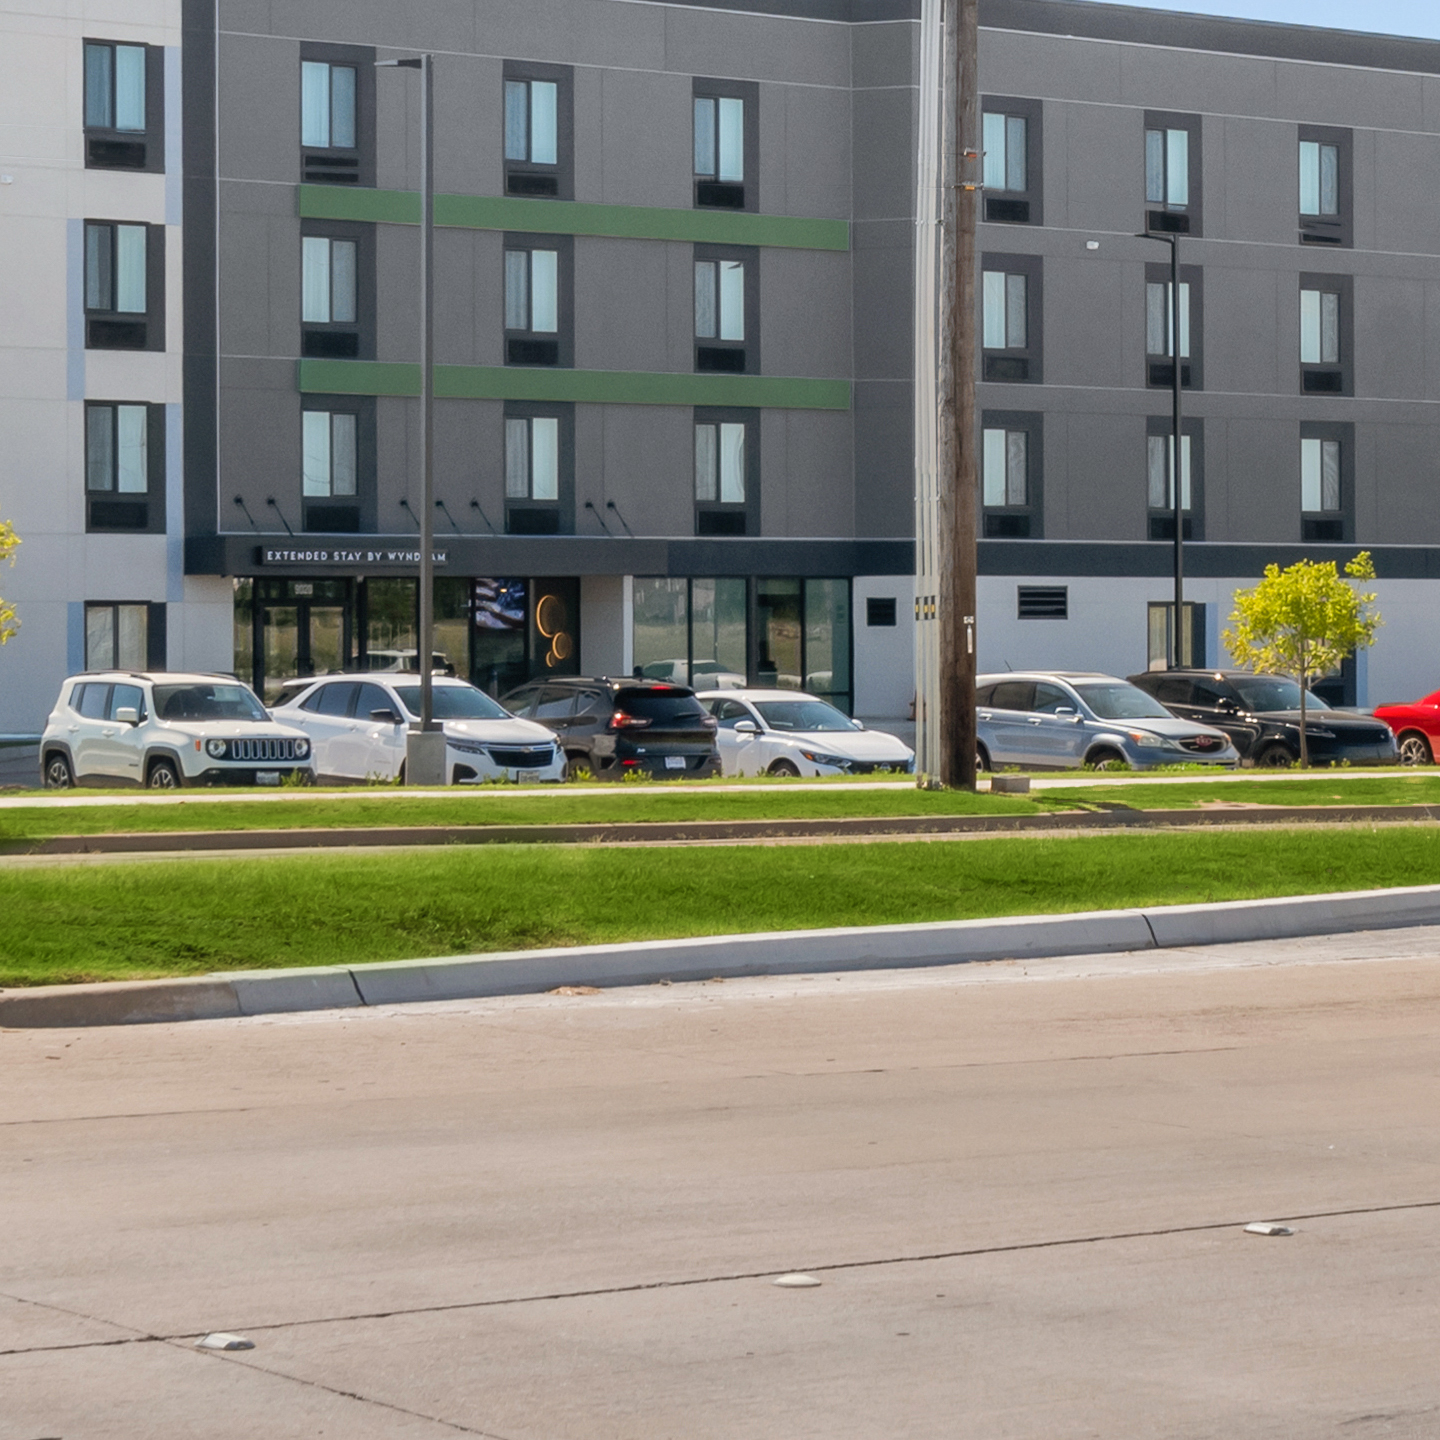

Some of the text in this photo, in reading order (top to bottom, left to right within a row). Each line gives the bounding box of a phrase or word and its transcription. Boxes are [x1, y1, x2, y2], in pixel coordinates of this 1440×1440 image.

[266, 550, 447, 562] EXTENDED STAY BY WYNDAM
